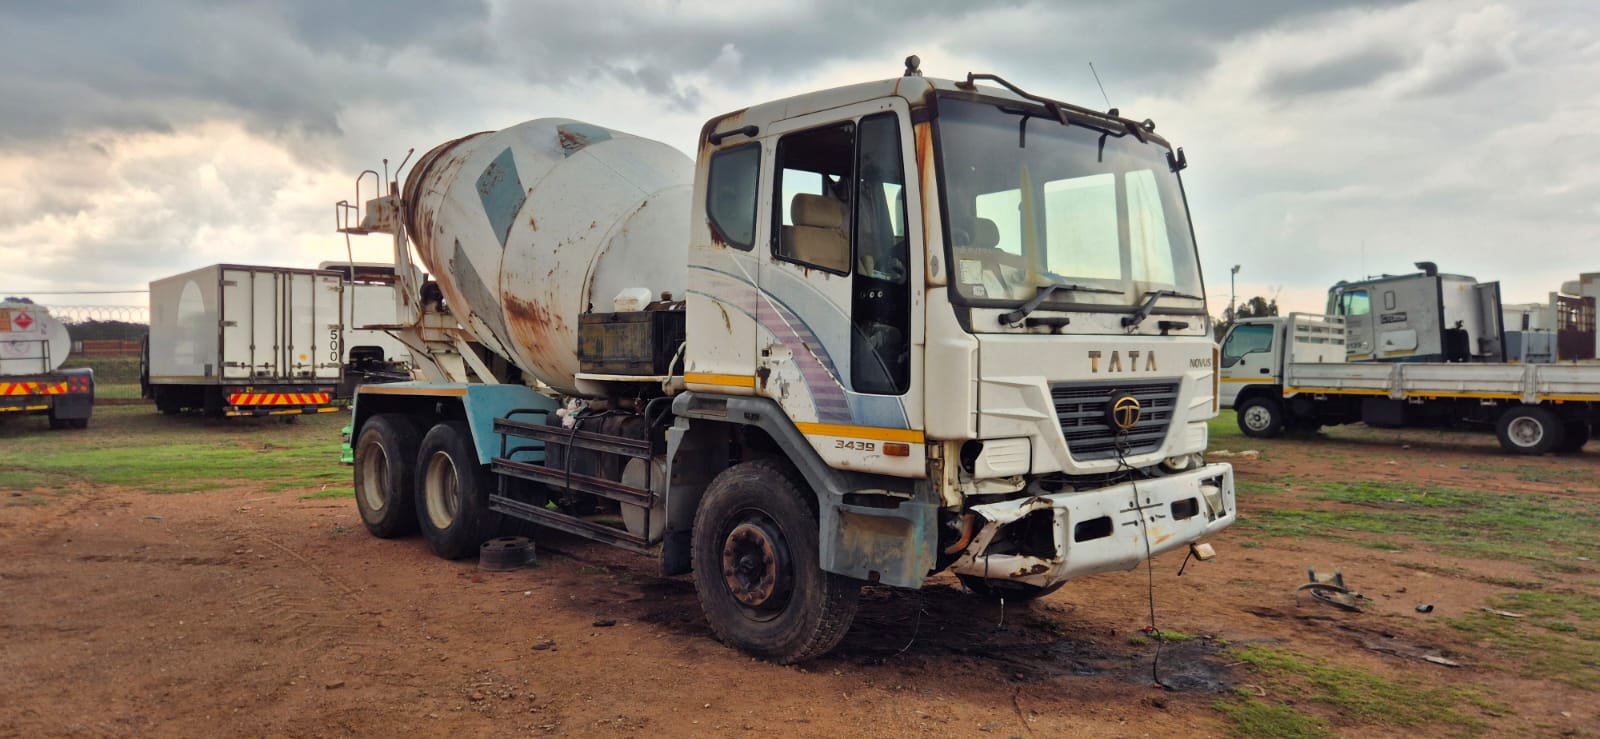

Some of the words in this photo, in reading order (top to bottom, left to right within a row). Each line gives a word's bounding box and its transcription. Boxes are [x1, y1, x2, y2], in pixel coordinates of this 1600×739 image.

[329, 330, 338, 362] 500
[1088, 350, 1157, 373] TATA
[1189, 358, 1211, 368] NOVUS
[835, 439, 875, 452] 3439
